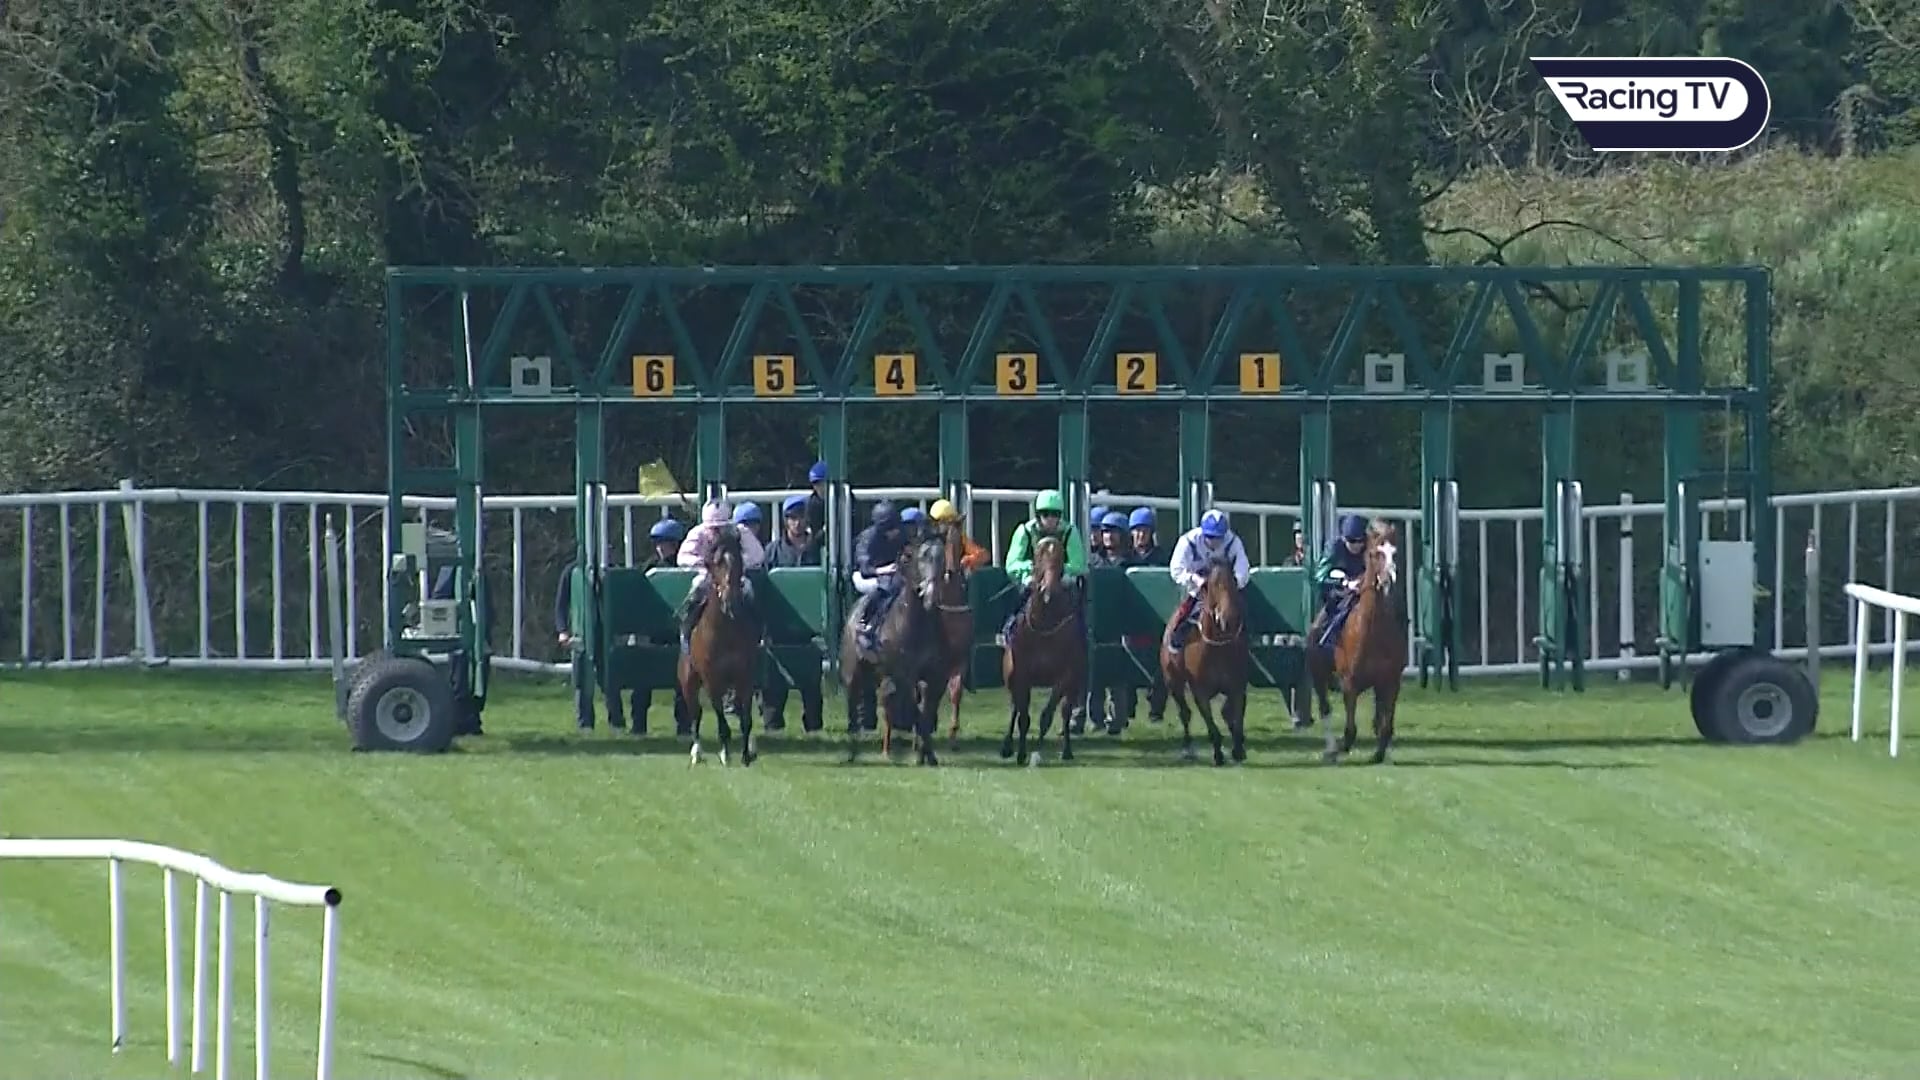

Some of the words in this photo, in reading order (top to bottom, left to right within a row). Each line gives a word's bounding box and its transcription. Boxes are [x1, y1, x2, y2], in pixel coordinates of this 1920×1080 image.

[645, 359, 665, 392] 6
[765, 359, 784, 392] 5
[885, 358, 905, 391] 4
[1008, 357, 1027, 390] 3
[1127, 357, 1145, 390] 2
[1253, 357, 1265, 389] 1
